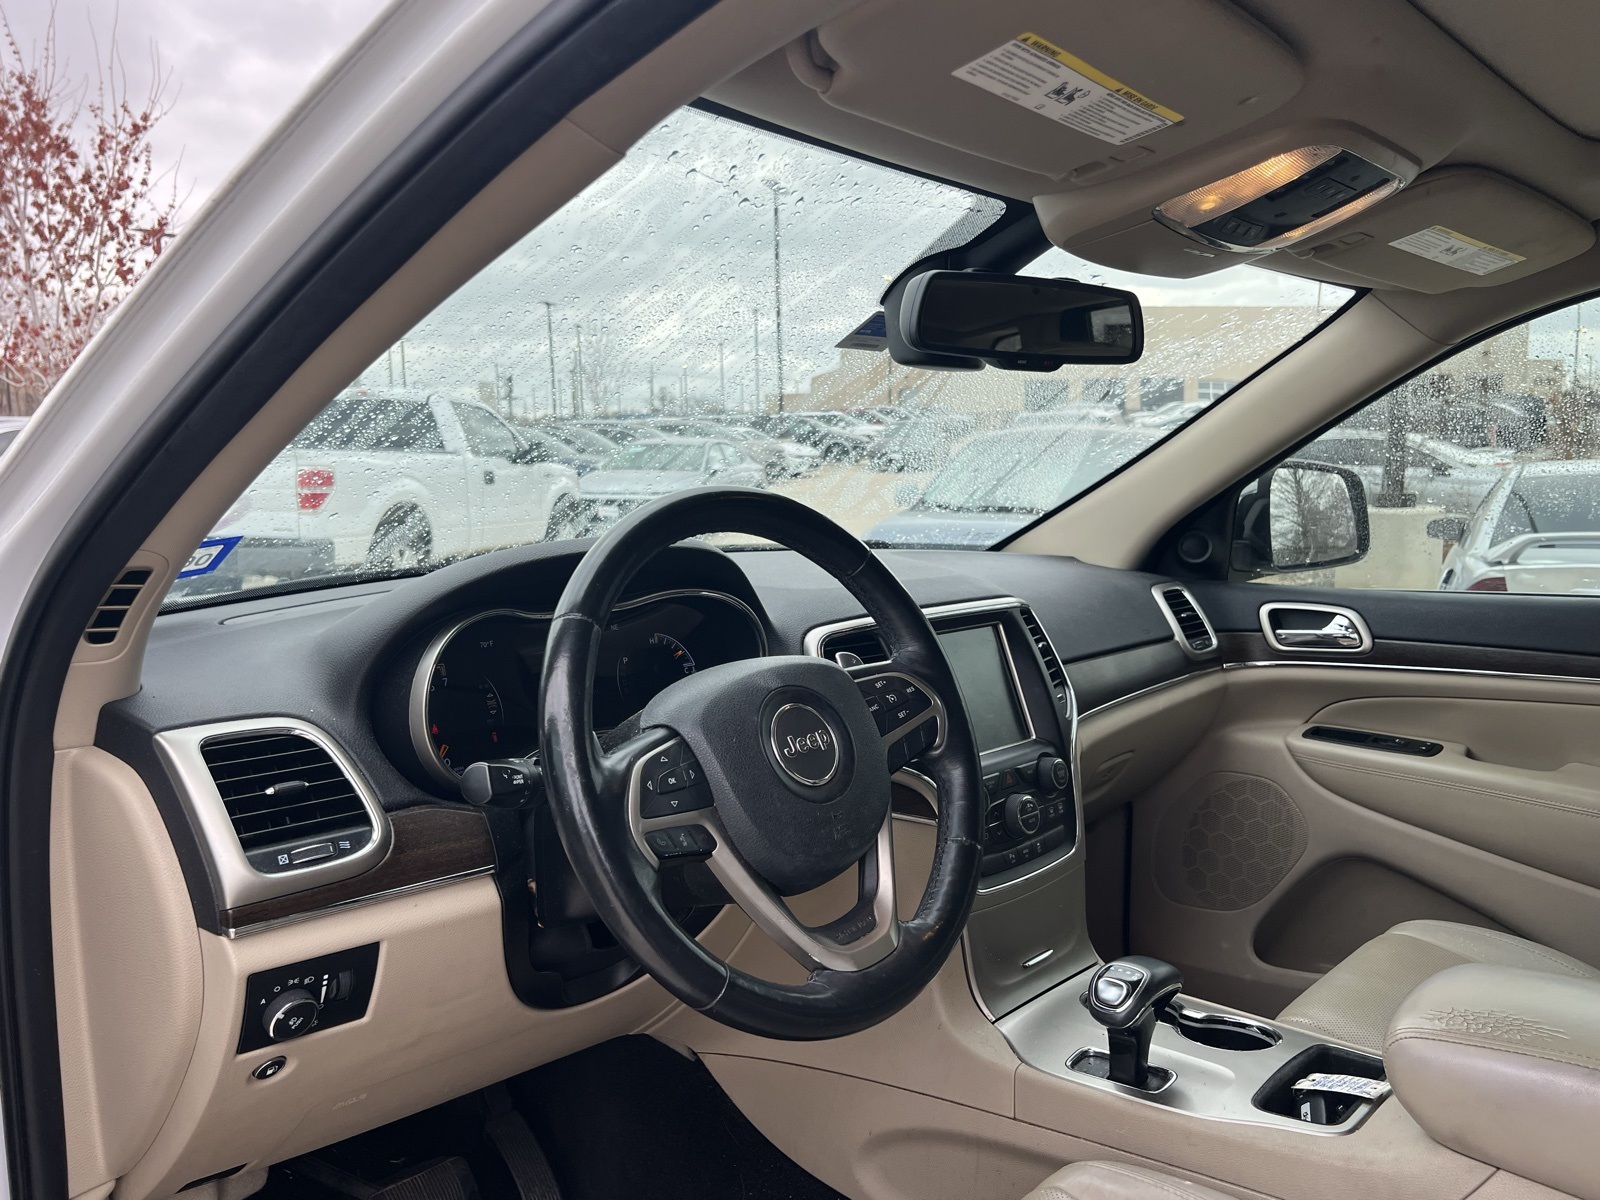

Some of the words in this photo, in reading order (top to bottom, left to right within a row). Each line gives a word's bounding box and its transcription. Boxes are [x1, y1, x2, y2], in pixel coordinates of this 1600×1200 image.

[906, 685, 915, 693] RES
[783, 729, 831, 758] Jeep
[667, 777, 677, 785] OK
